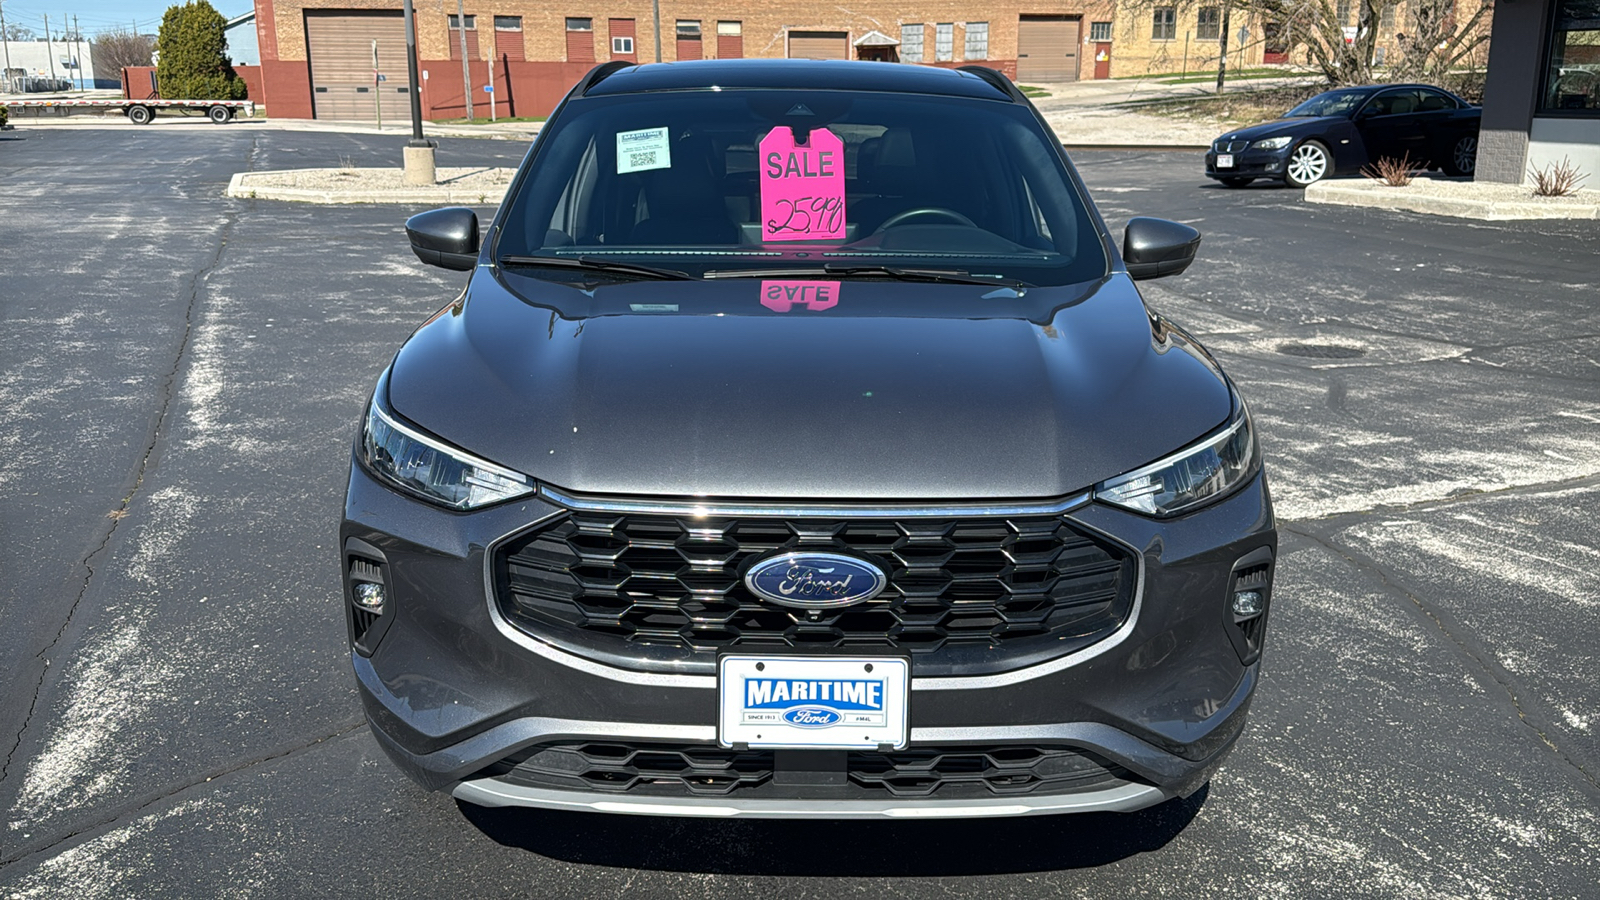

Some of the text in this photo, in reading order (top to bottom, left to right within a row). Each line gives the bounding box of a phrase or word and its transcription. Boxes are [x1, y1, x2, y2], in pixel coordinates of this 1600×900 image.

[767, 152, 834, 179] SALE
[779, 565, 853, 595] Ford
[747, 680, 881, 709] MARITIME
[793, 710, 831, 724] Ford
